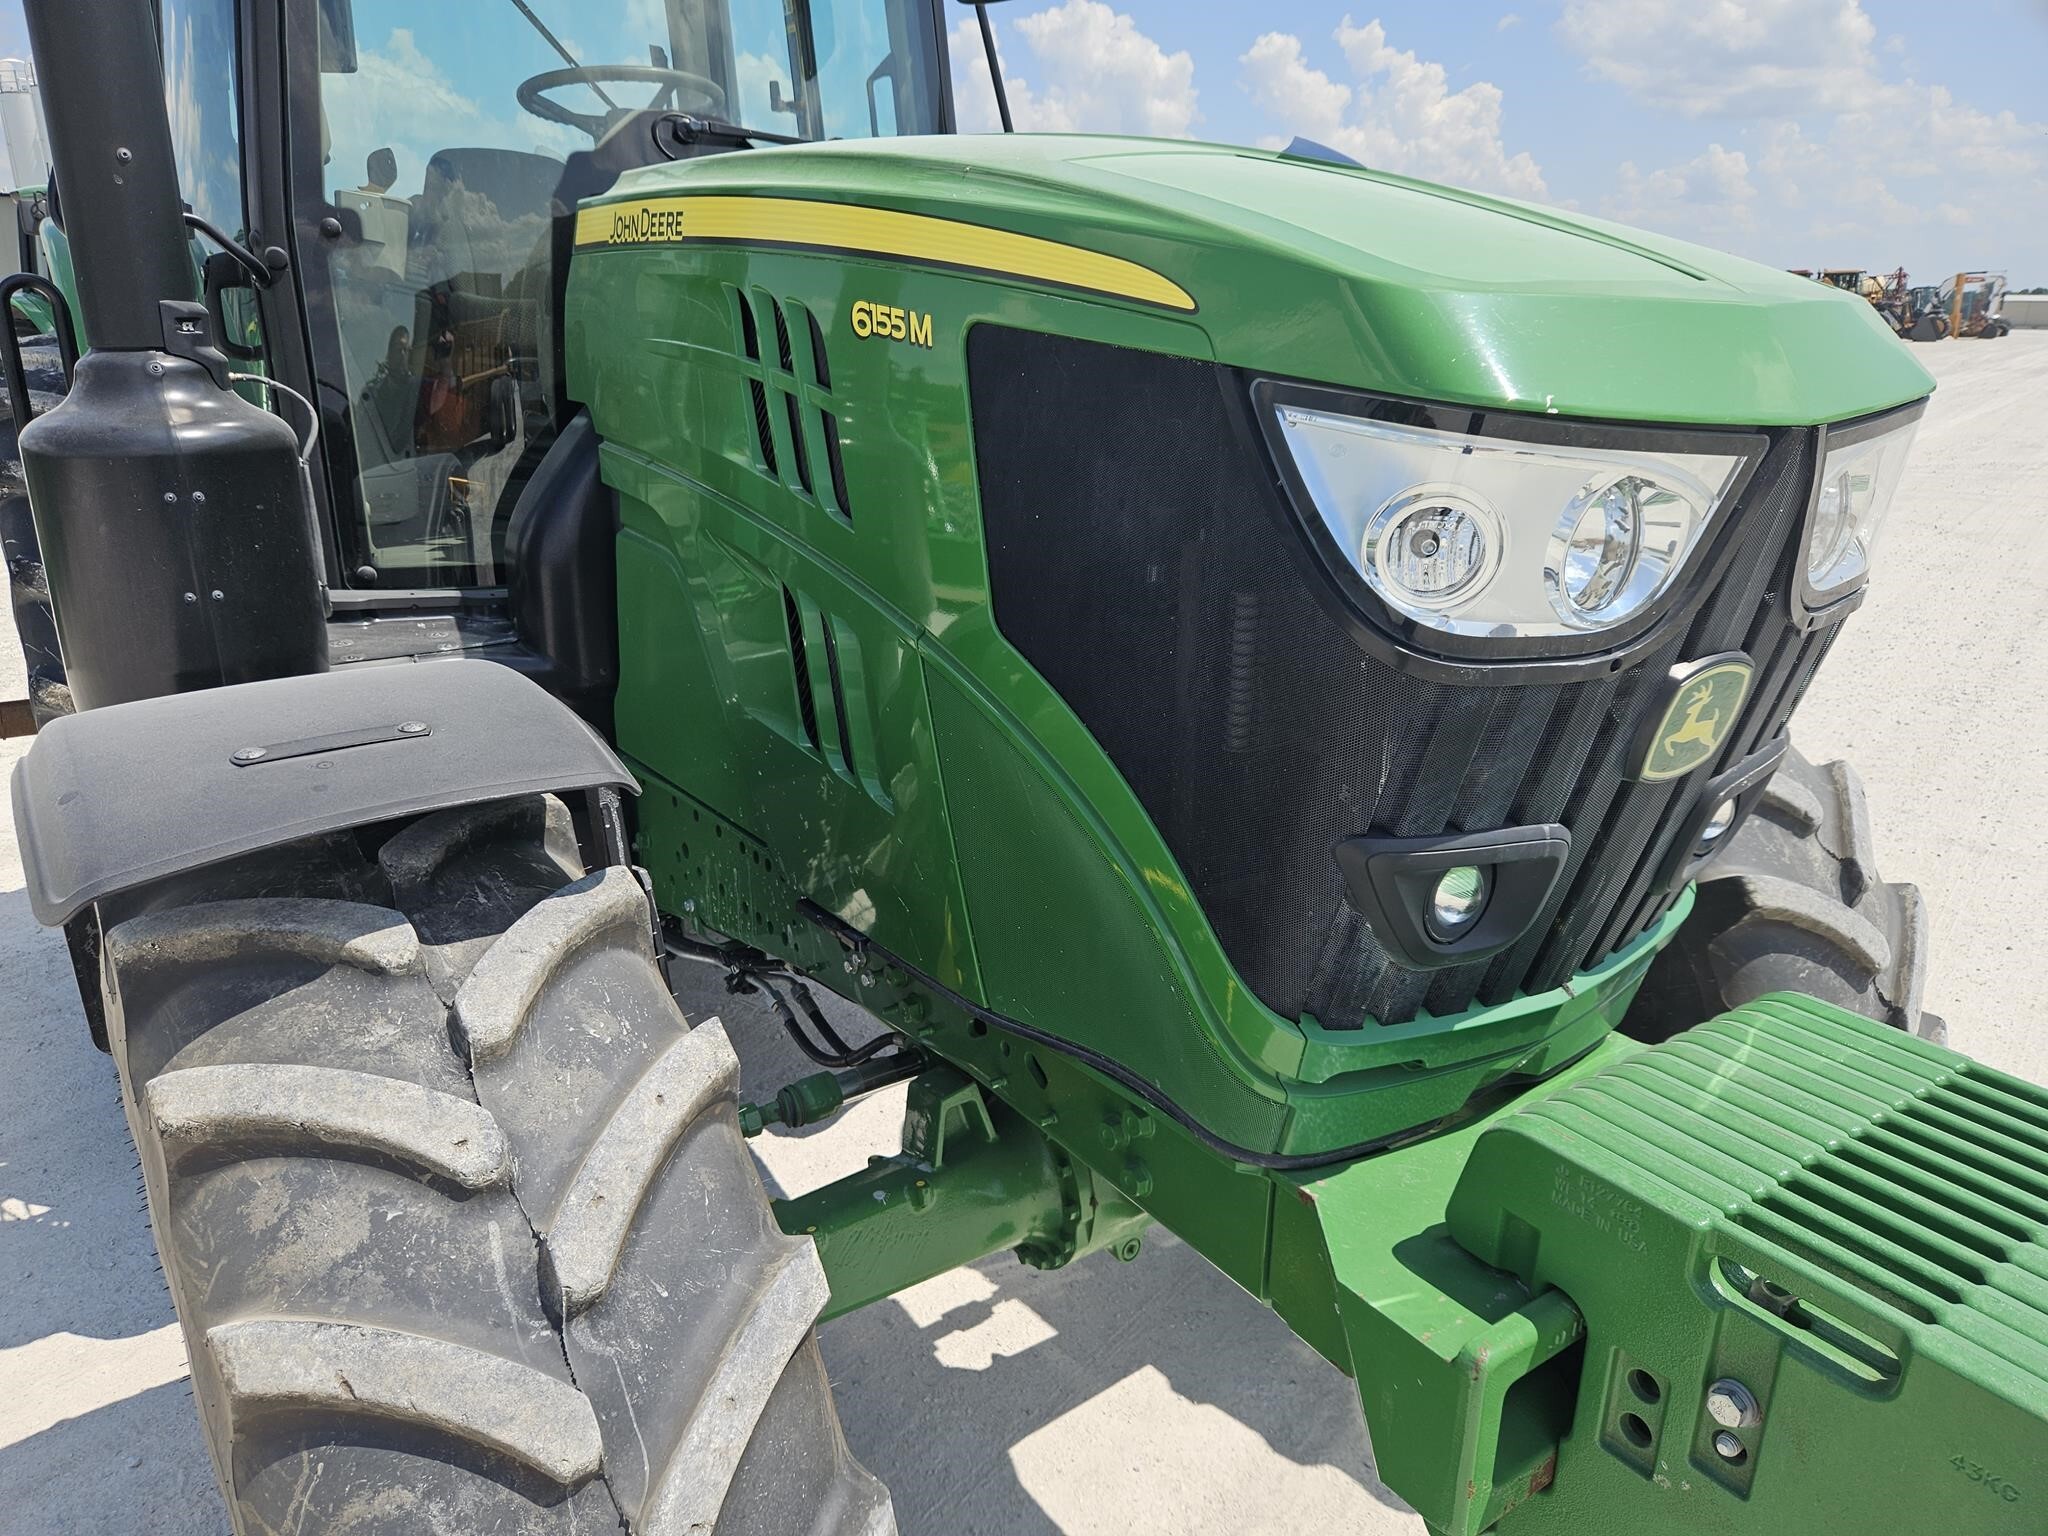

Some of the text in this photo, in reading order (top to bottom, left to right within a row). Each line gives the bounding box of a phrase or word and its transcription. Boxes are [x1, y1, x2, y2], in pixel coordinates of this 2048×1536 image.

[610, 208, 683, 240] JOHN DEERE
[1949, 1455, 2021, 1503] 43KG
